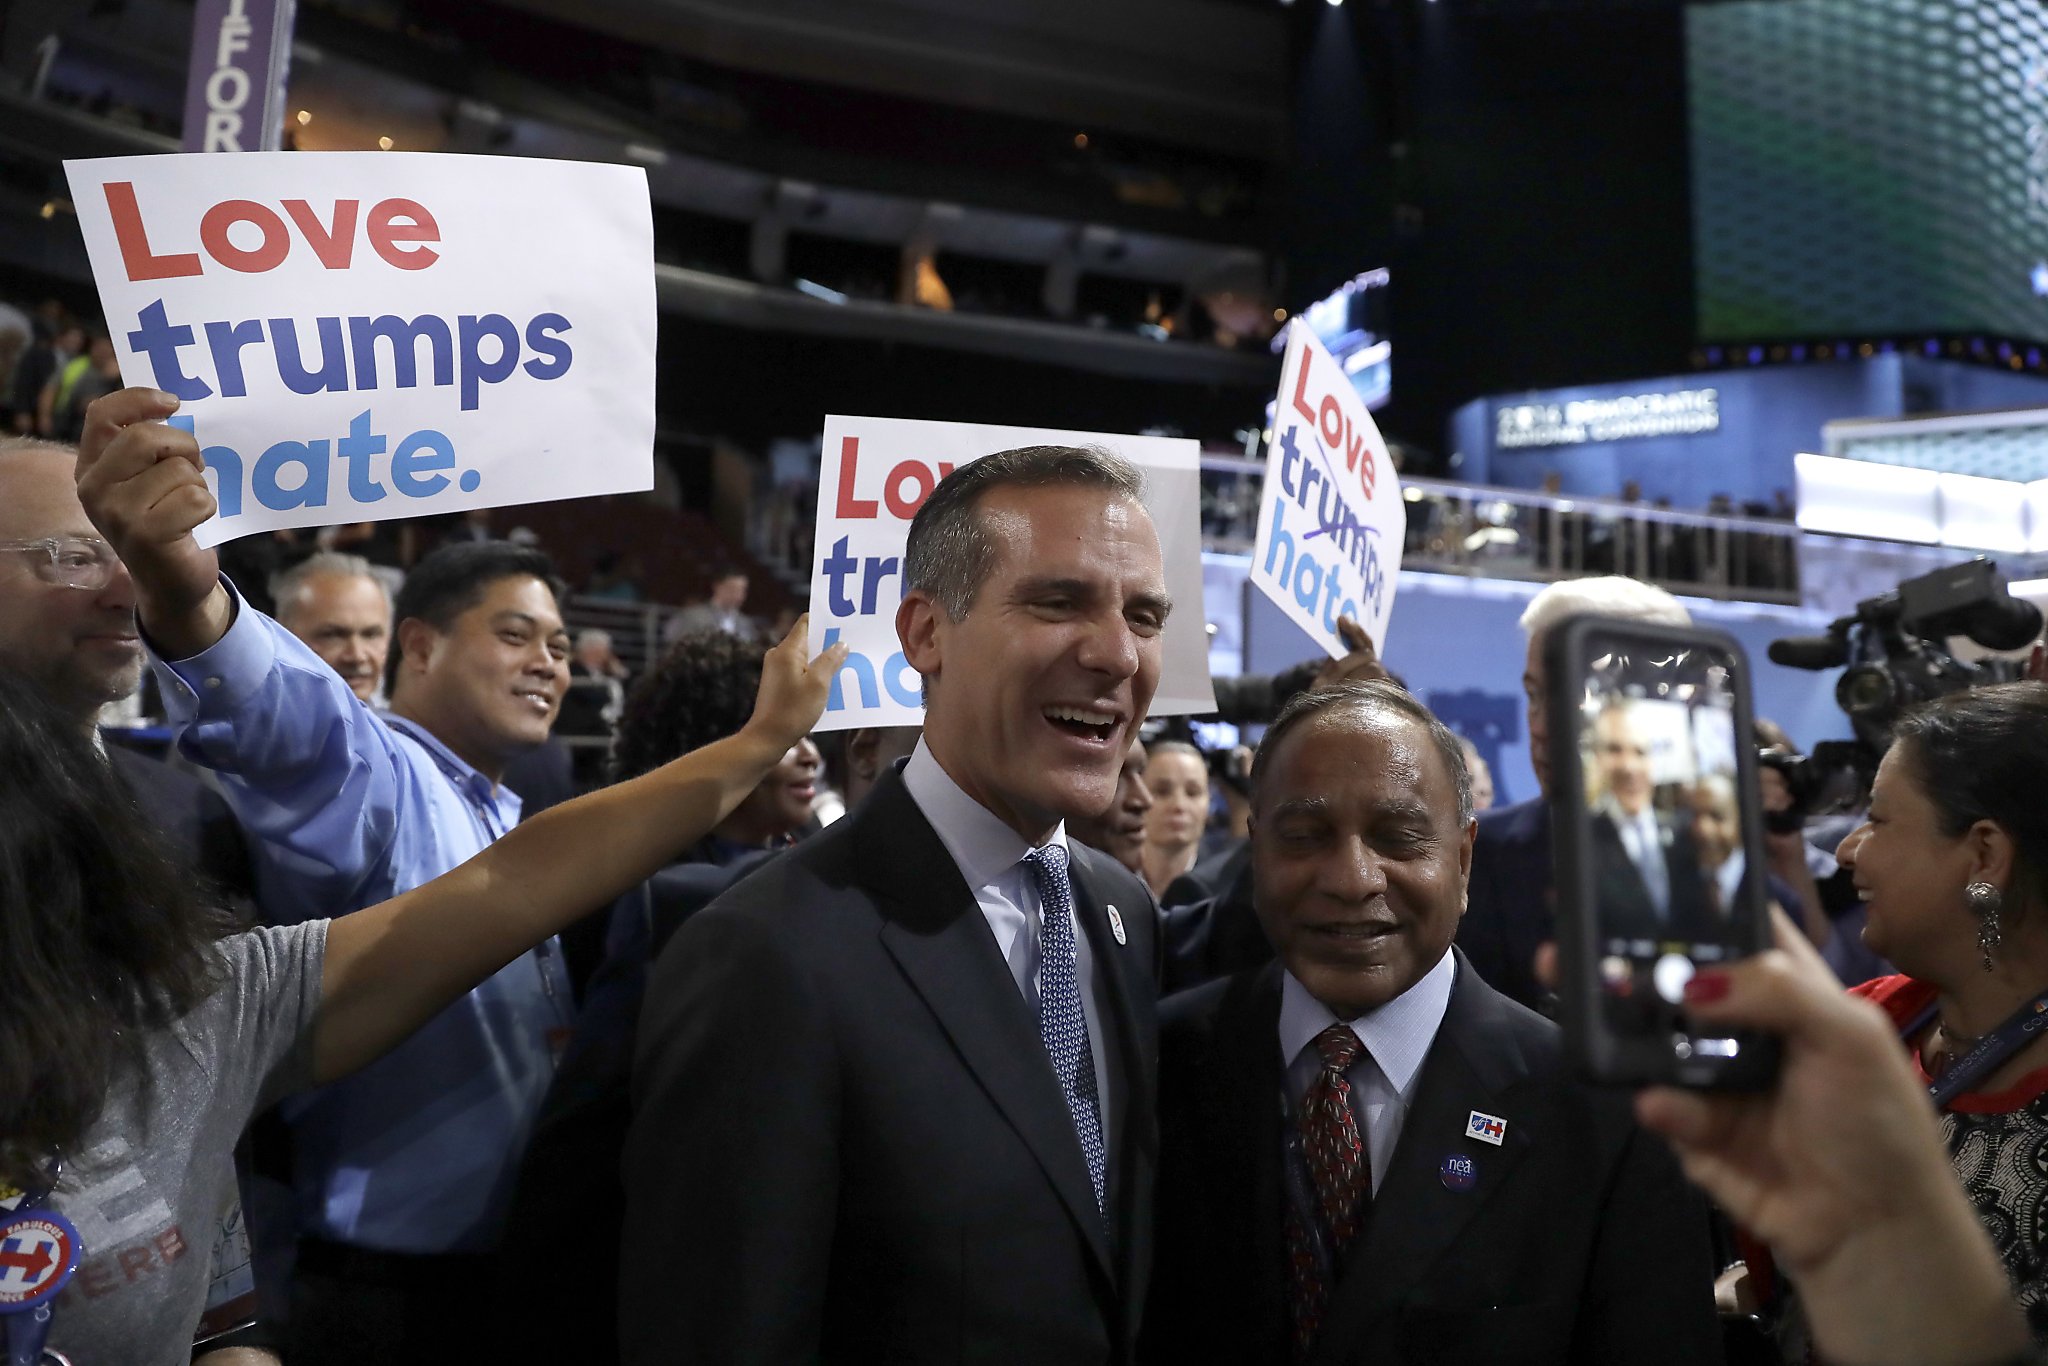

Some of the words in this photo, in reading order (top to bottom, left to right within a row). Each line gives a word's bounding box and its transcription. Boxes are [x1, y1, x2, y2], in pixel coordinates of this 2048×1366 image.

[103, 181, 441, 282] Love
[127, 298, 573, 411] trumps
[1293, 343, 1376, 501] Love
[836, 437, 955, 519] Lo
[822, 535, 907, 617] tr
[1449, 1159, 1471, 1174] nea
[6, 1220, 65, 1240] FABULOUS
